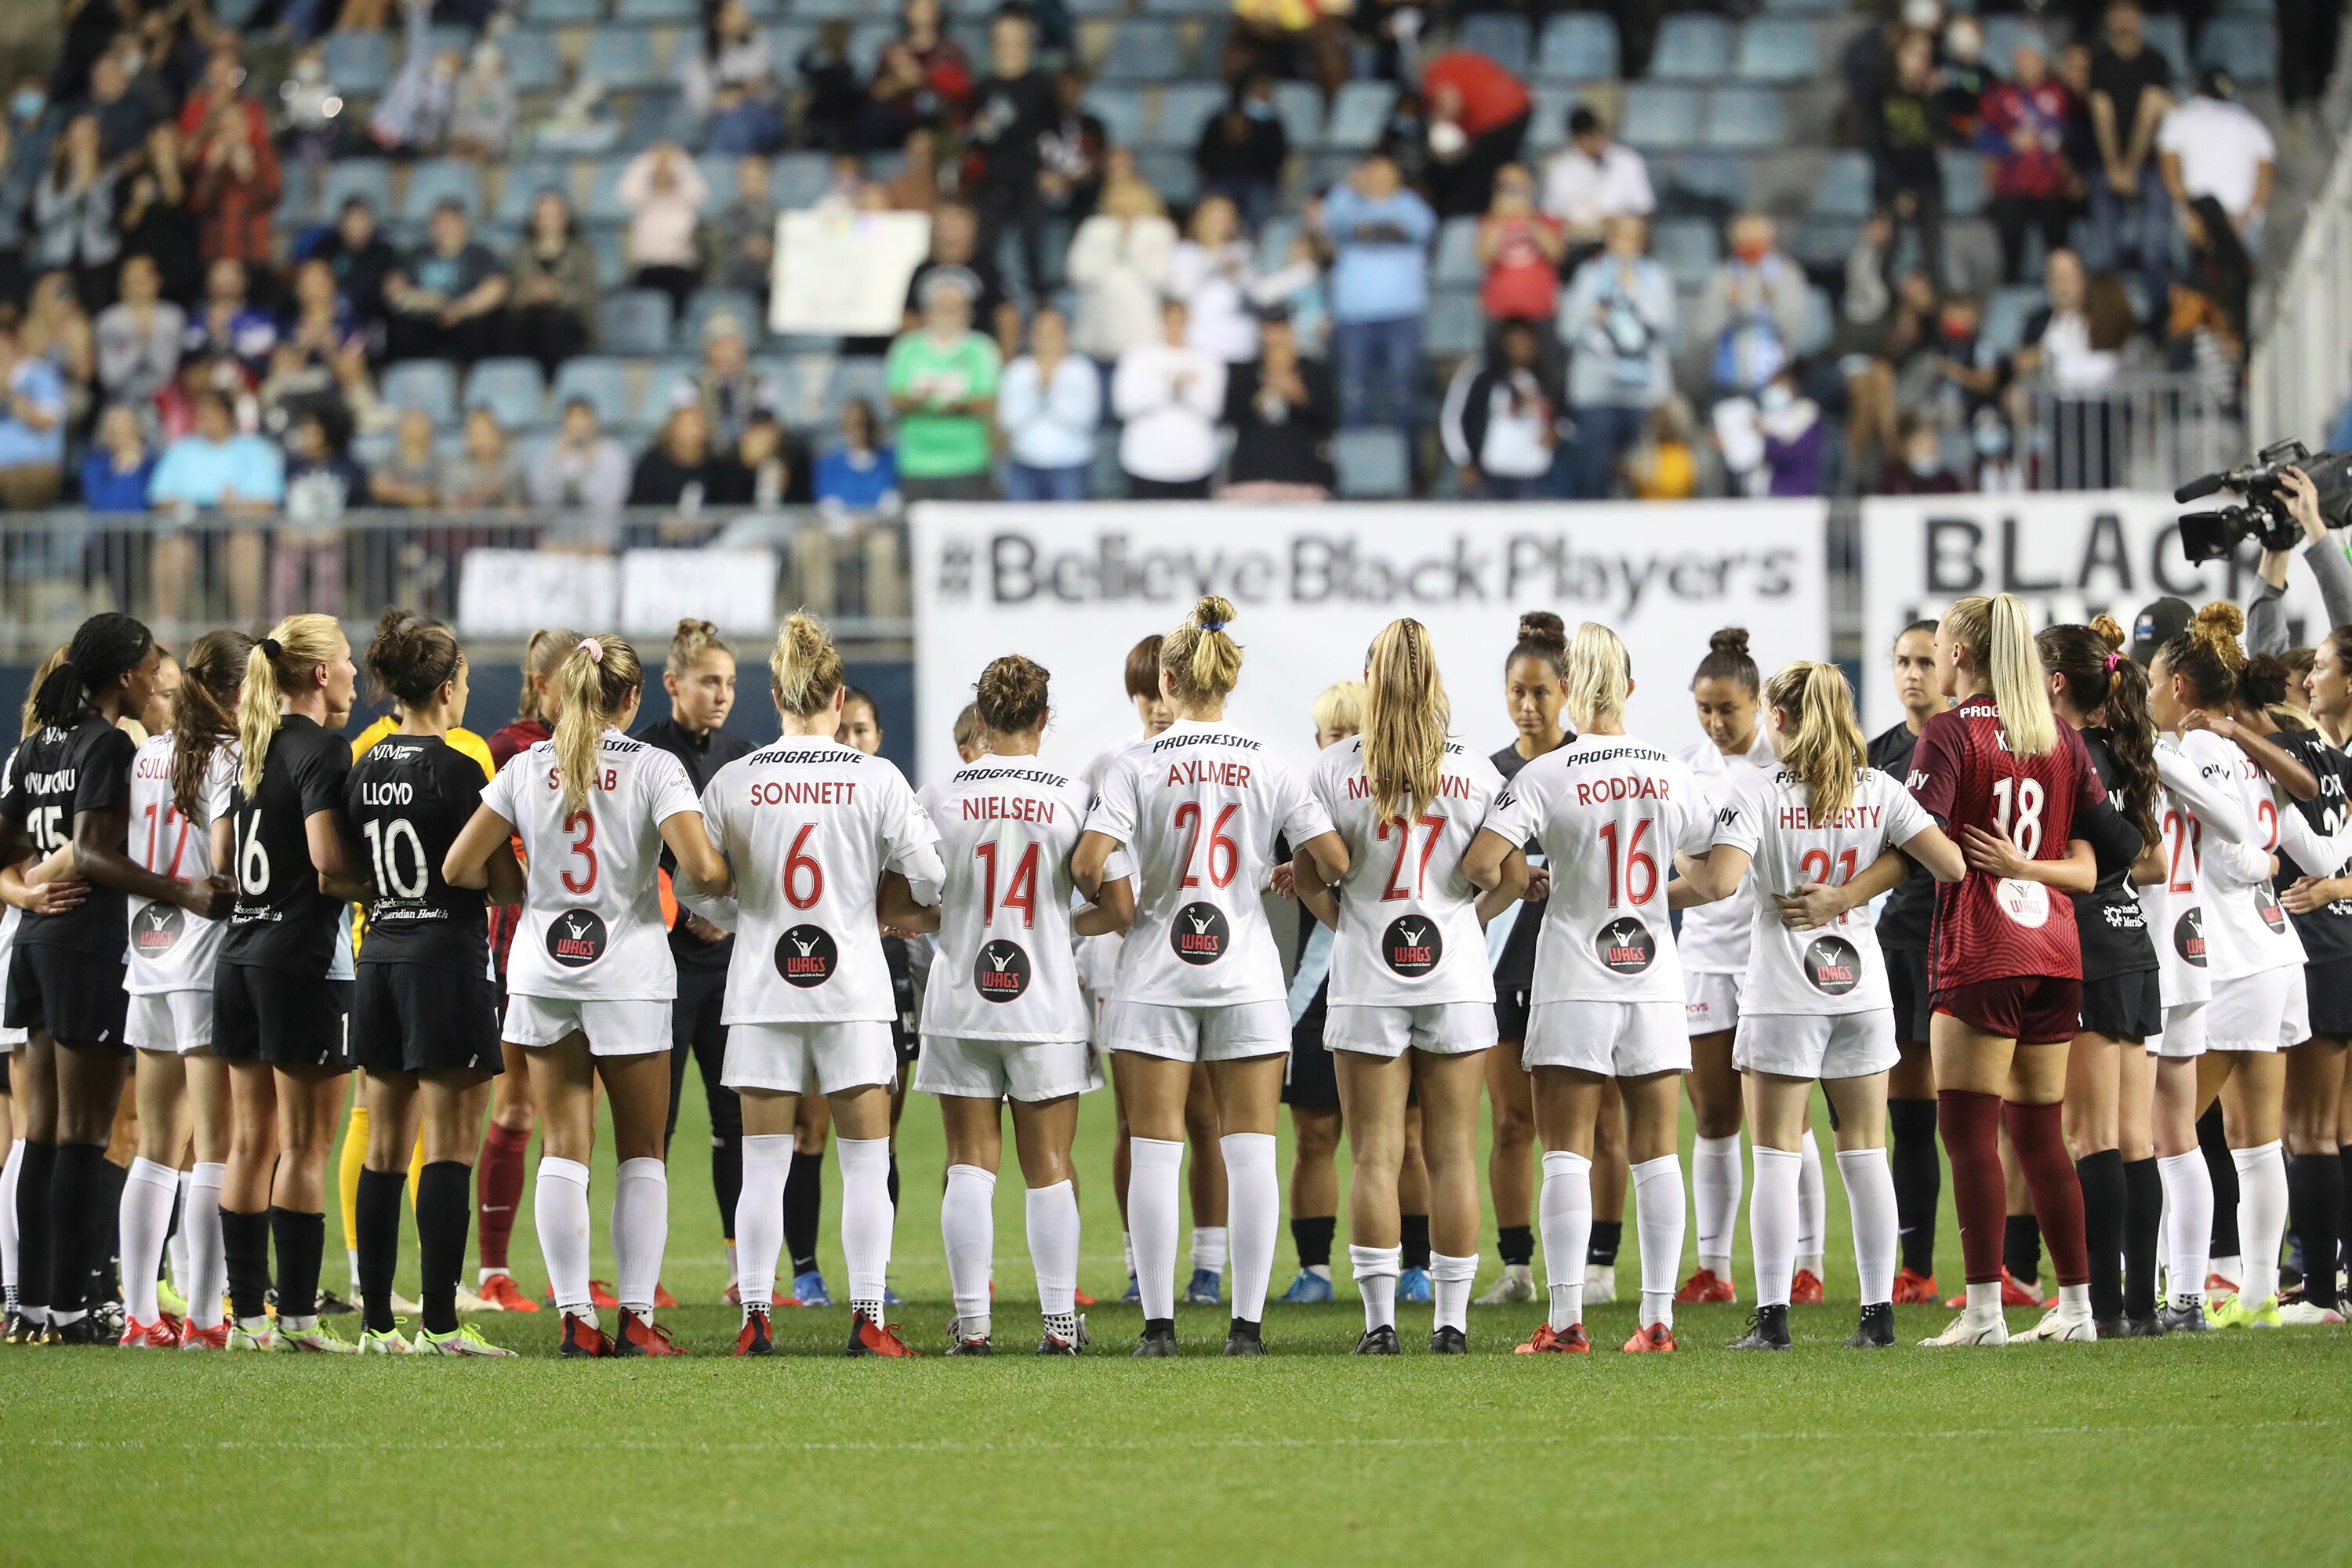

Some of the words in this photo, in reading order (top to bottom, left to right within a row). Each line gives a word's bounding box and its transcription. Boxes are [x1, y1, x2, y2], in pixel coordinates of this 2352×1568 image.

[938, 533, 1795, 621] #BelieveBlackPlayers
[367, 744, 401, 760] NJM
[537, 739, 647, 753] PSSIVE
[1152, 734, 1262, 753] PROGRESSIVE
[749, 750, 865, 767] PROGRESSIVE
[1566, 748, 1670, 768] PROGRESSIVE
[548, 768, 618, 791] SAB
[953, 768, 1069, 788] PROGRESSIVE
[1167, 760, 1250, 789] AYLMER
[363, 782, 413, 806] LLOYD
[751, 782, 856, 807] SONNETT
[1494, 790, 1517, 811] lly
[1577, 776, 1671, 807] RODDAR
[963, 797, 1054, 824] NIELSEN
[1717, 807, 1740, 826] lly
[1993, 777, 2045, 860] 18
[144, 802, 192, 884] 12
[560, 808, 597, 895] 3
[1174, 801, 1242, 891] 26
[363, 818, 429, 898] 10
[782, 822, 825, 911] 6
[1377, 814, 1449, 902] 27
[1598, 818, 1660, 909] 16
[975, 840, 1041, 929] 14
[1798, 847, 1859, 926] 21
[416, 908, 449, 920] Health
[557, 938, 595, 956] WAGS
[1181, 933, 1218, 951] WAGS
[2186, 939, 2205, 954] WA
[787, 956, 826, 973] WAGS
[1394, 946, 1432, 963] WAGS
[1608, 946, 1646, 962] WAGS
[982, 971, 1019, 989] WAGS
[1817, 965, 1853, 982] WAGS
